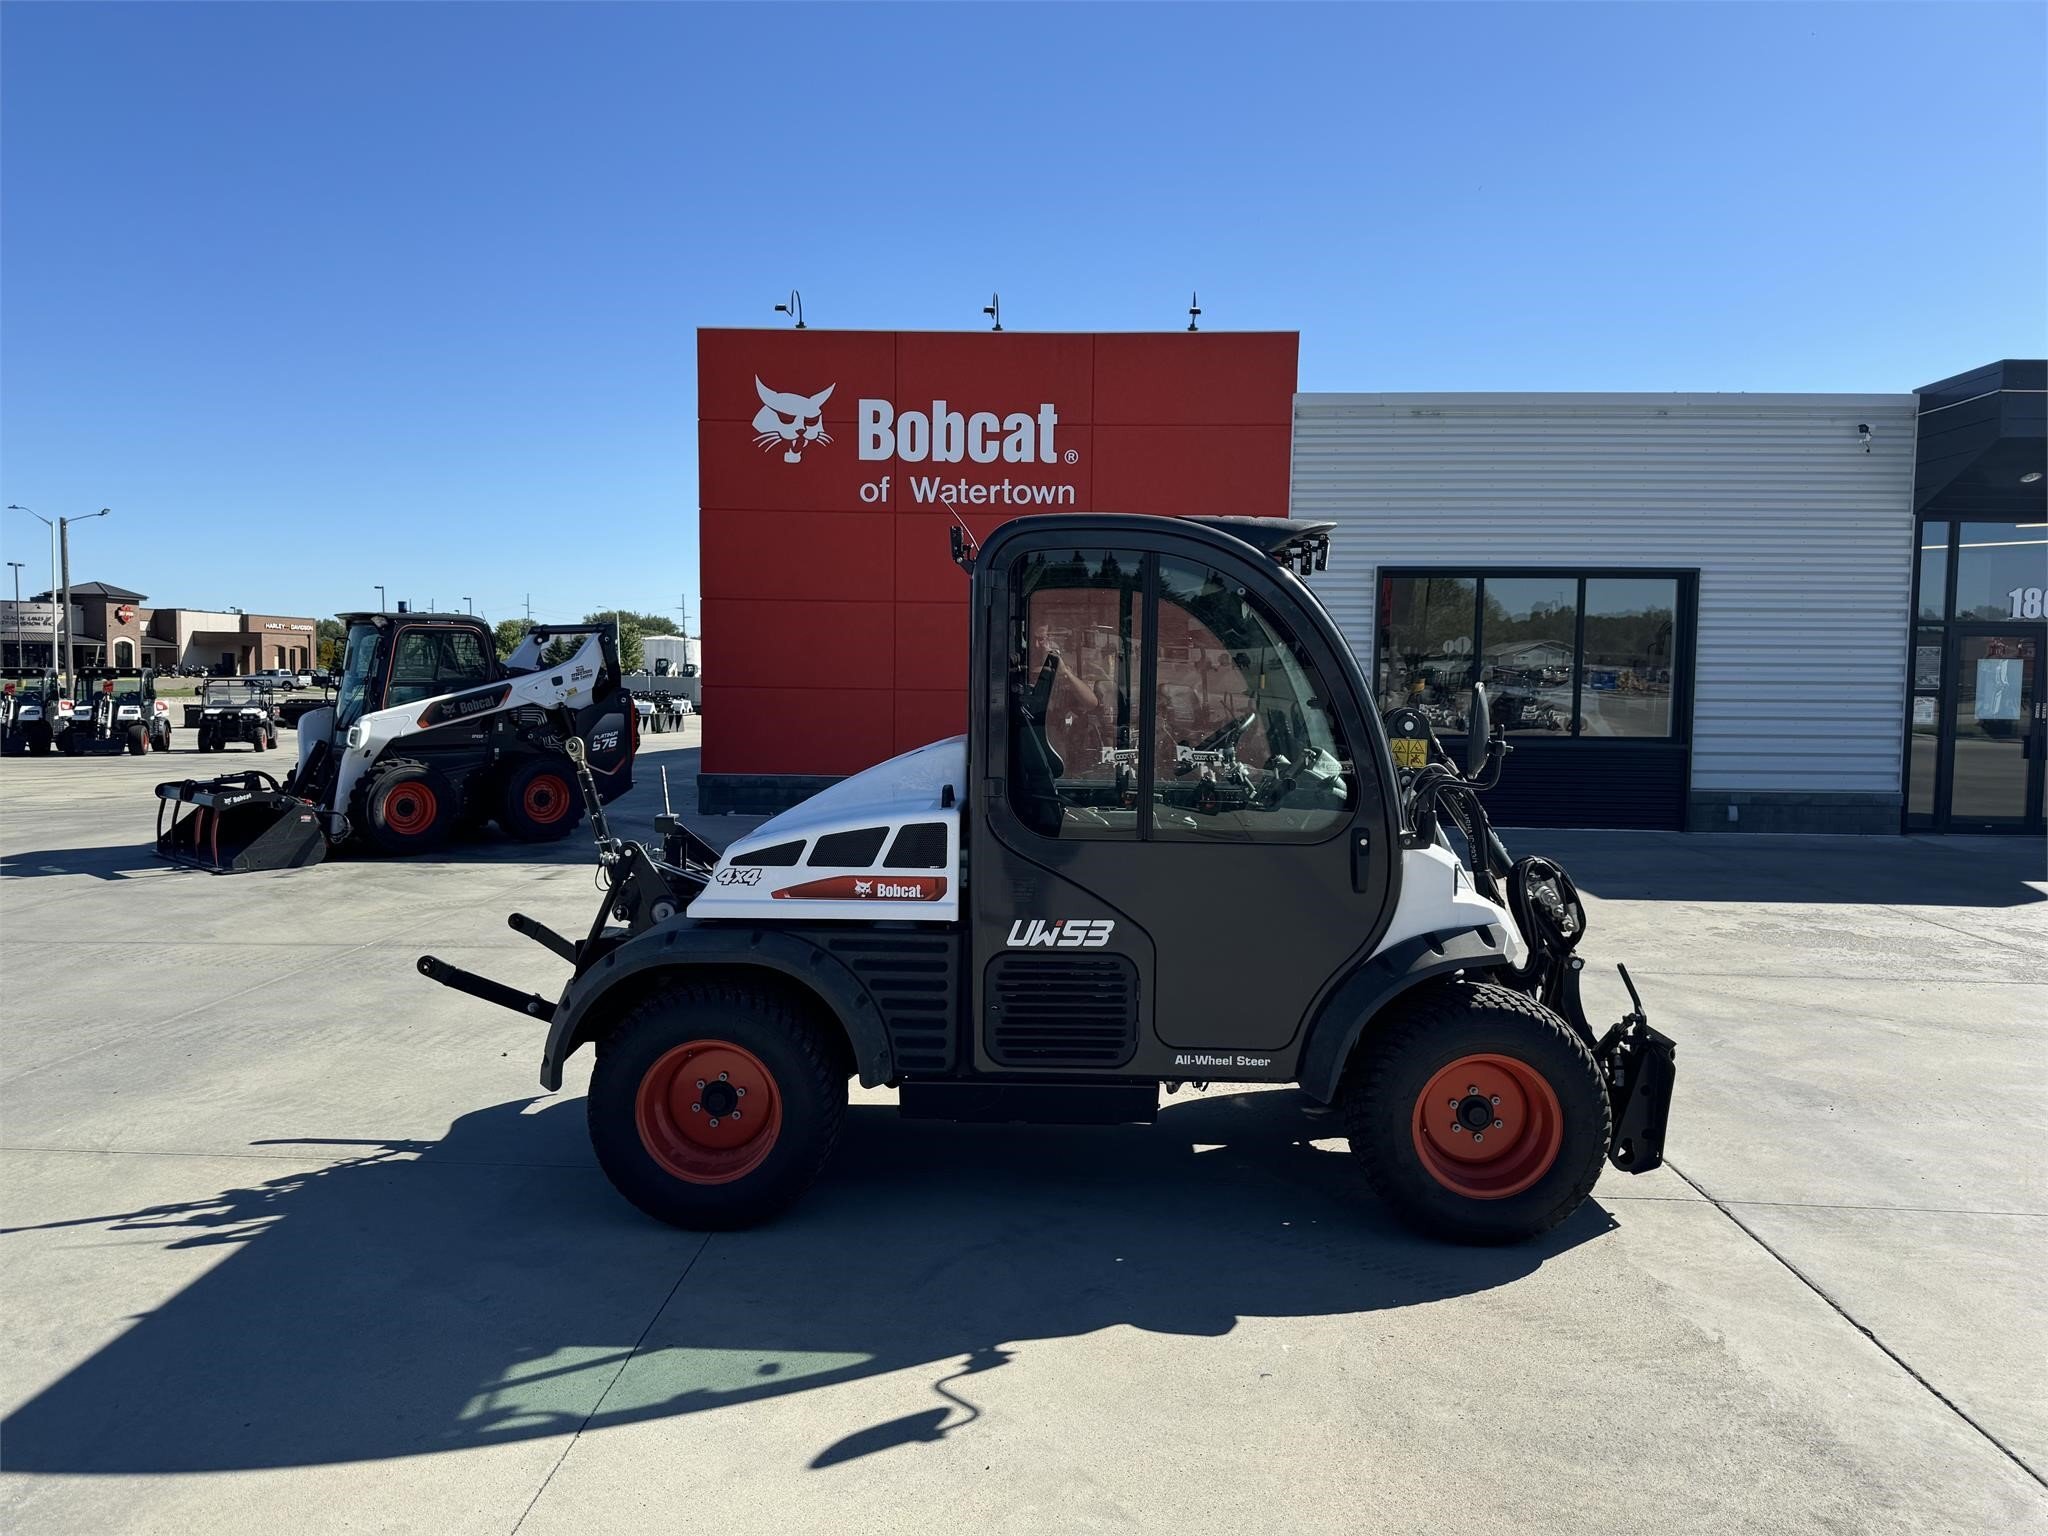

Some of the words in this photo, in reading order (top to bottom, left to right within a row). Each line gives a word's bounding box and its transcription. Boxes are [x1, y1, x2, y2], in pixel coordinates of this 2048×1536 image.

[858, 398, 1058, 464] Bobcat
[859, 476, 890, 503] of
[909, 476, 1076, 505] Watertown
[459, 696, 496, 714] Bobcat
[592, 736, 618, 752] S76
[593, 730, 619, 740] PLATINUM
[715, 867, 762, 886] 4x4
[877, 883, 921, 898] Bobcat
[1006, 919, 1115, 946] UW53
[1174, 1054, 1233, 1066] All-Wheel
[1236, 1055, 1271, 1067] Steer
